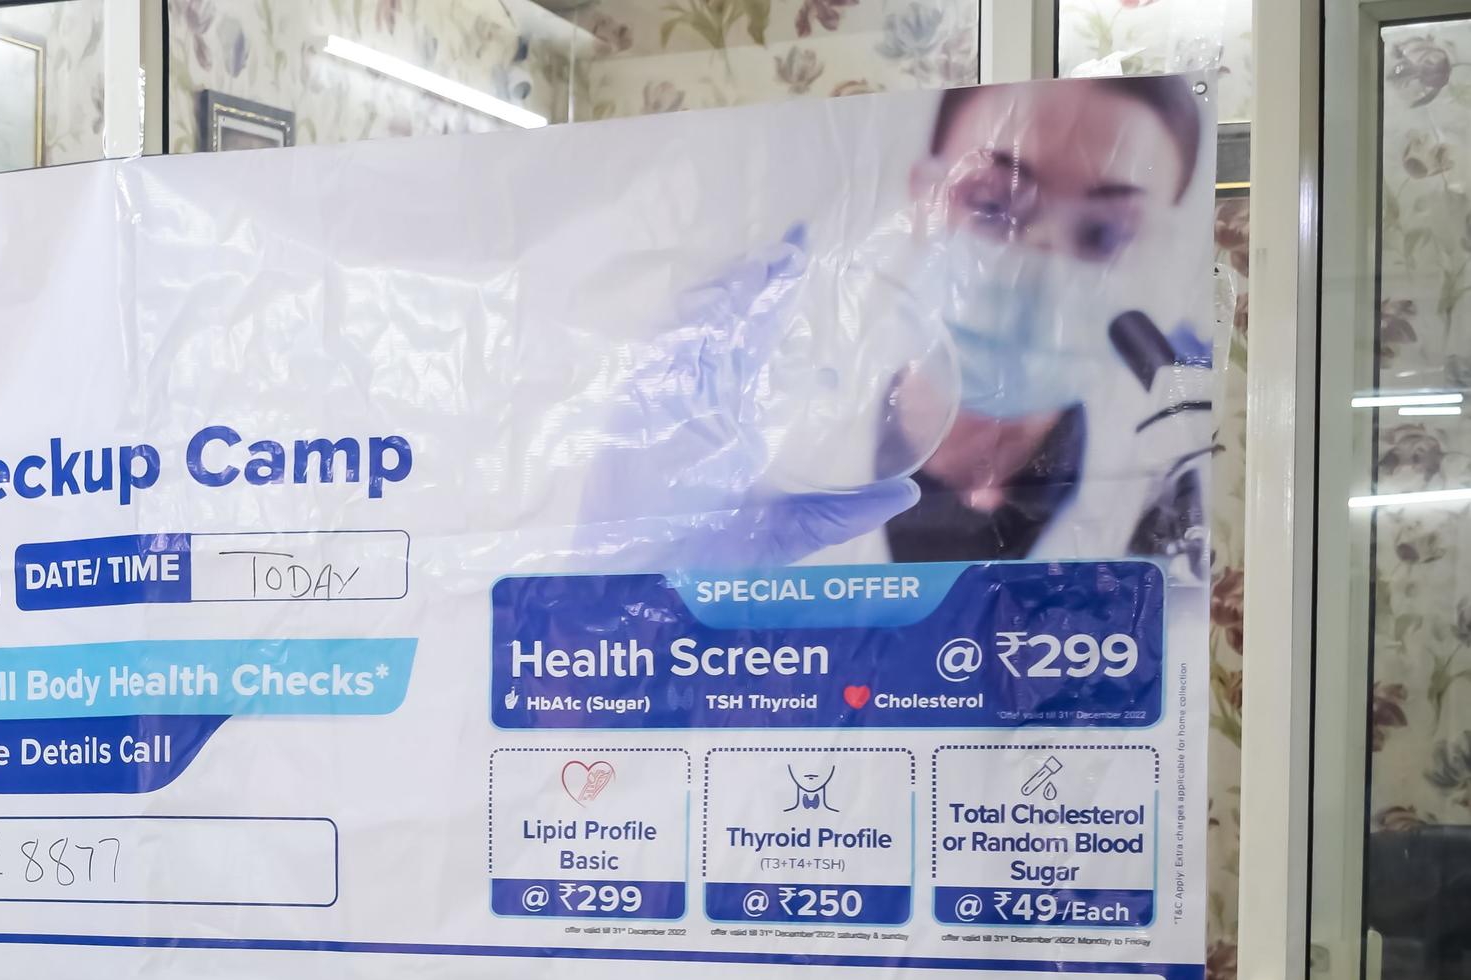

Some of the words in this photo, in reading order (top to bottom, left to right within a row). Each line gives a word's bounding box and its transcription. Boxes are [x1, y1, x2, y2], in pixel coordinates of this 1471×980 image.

[186, 425, 413, 498] Camp
[25, 556, 101, 590] DATE/
[107, 554, 180, 583] TIME
[218, 551, 360, 601] TODAY
[696, 578, 815, 603] SPECIAL
[824, 576, 920, 600] OFFER
[510, 639, 655, 678] Health
[670, 638, 829, 678] Screen
[936, 637, 983, 683] @
[995, 631, 1138, 678] ₹299
[27, 668, 101, 706] Body
[109, 664, 219, 697] Health
[1178, 662, 1188, 706] collection
[586, 695, 651, 714] (Sugar)
[705, 695, 743, 710] TSH
[749, 694, 818, 713] Thyroid
[874, 693, 984, 709] Cholesterol
[1124, 710, 1147, 720] 2022
[1178, 710, 1186, 736] home
[21, 736, 112, 765] Details
[119, 735, 171, 763] Call
[1178, 739, 1186, 751] for
[1176, 754, 1186, 802] applicable
[949, 803, 1006, 824] Total
[1011, 803, 1145, 825] Cholesterol
[1176, 805, 1187, 841] charges
[523, 820, 577, 843] Lipid
[584, 820, 658, 841] Profile
[726, 827, 811, 852] Thyroid
[817, 827, 893, 849] Profile
[942, 835, 966, 852] or
[971, 831, 1069, 853] Random
[1075, 832, 1144, 854] Blood
[559, 850, 620, 870] Basic
[759, 857, 846, 872] (T3+T4+TSH)
[1174, 844, 1184, 868] Extra
[1010, 859, 1080, 886] Sugar
[521, 885, 550, 913] @
[558, 882, 643, 913] ₹299
[742, 889, 770, 917] @
[778, 887, 863, 917] ₹250
[955, 893, 983, 922] @
